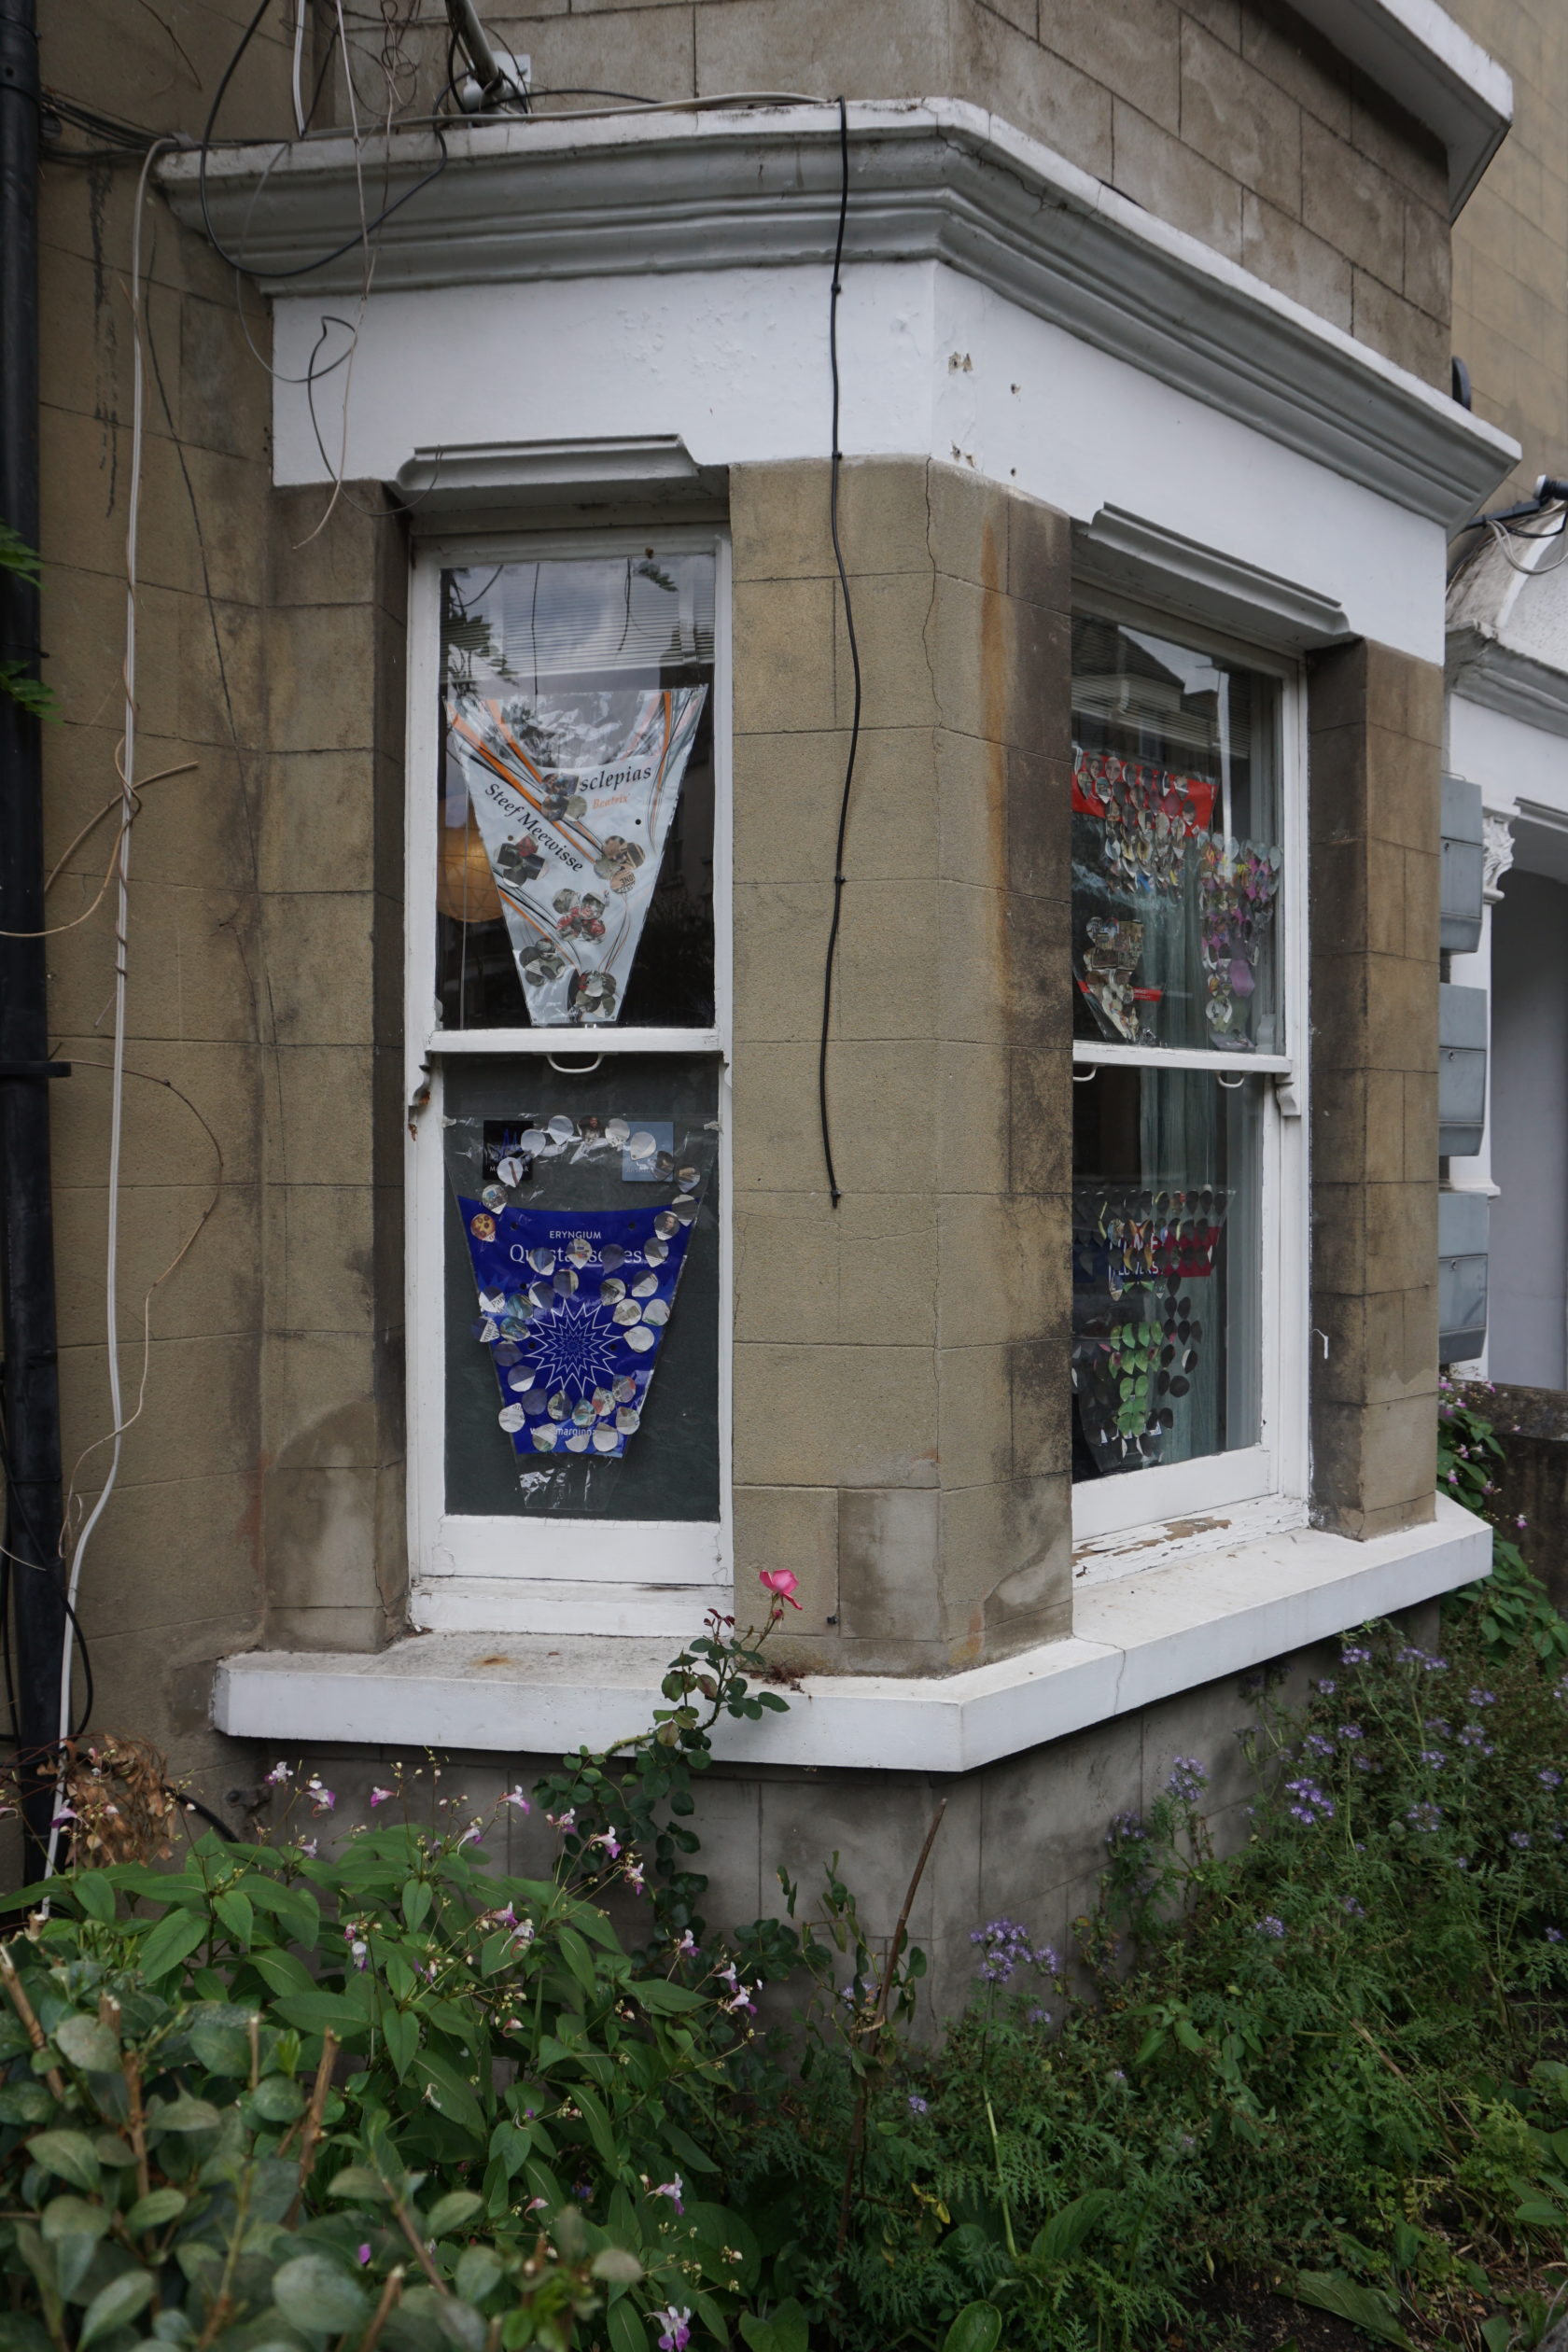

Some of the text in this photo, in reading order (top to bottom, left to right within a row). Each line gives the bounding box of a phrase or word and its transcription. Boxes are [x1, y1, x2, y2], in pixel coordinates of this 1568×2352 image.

[580, 765, 651, 791] sclepias
[484, 783, 583, 872] Steef Meewisse
[549, 1230, 601, 1239] ERYNGIUM
